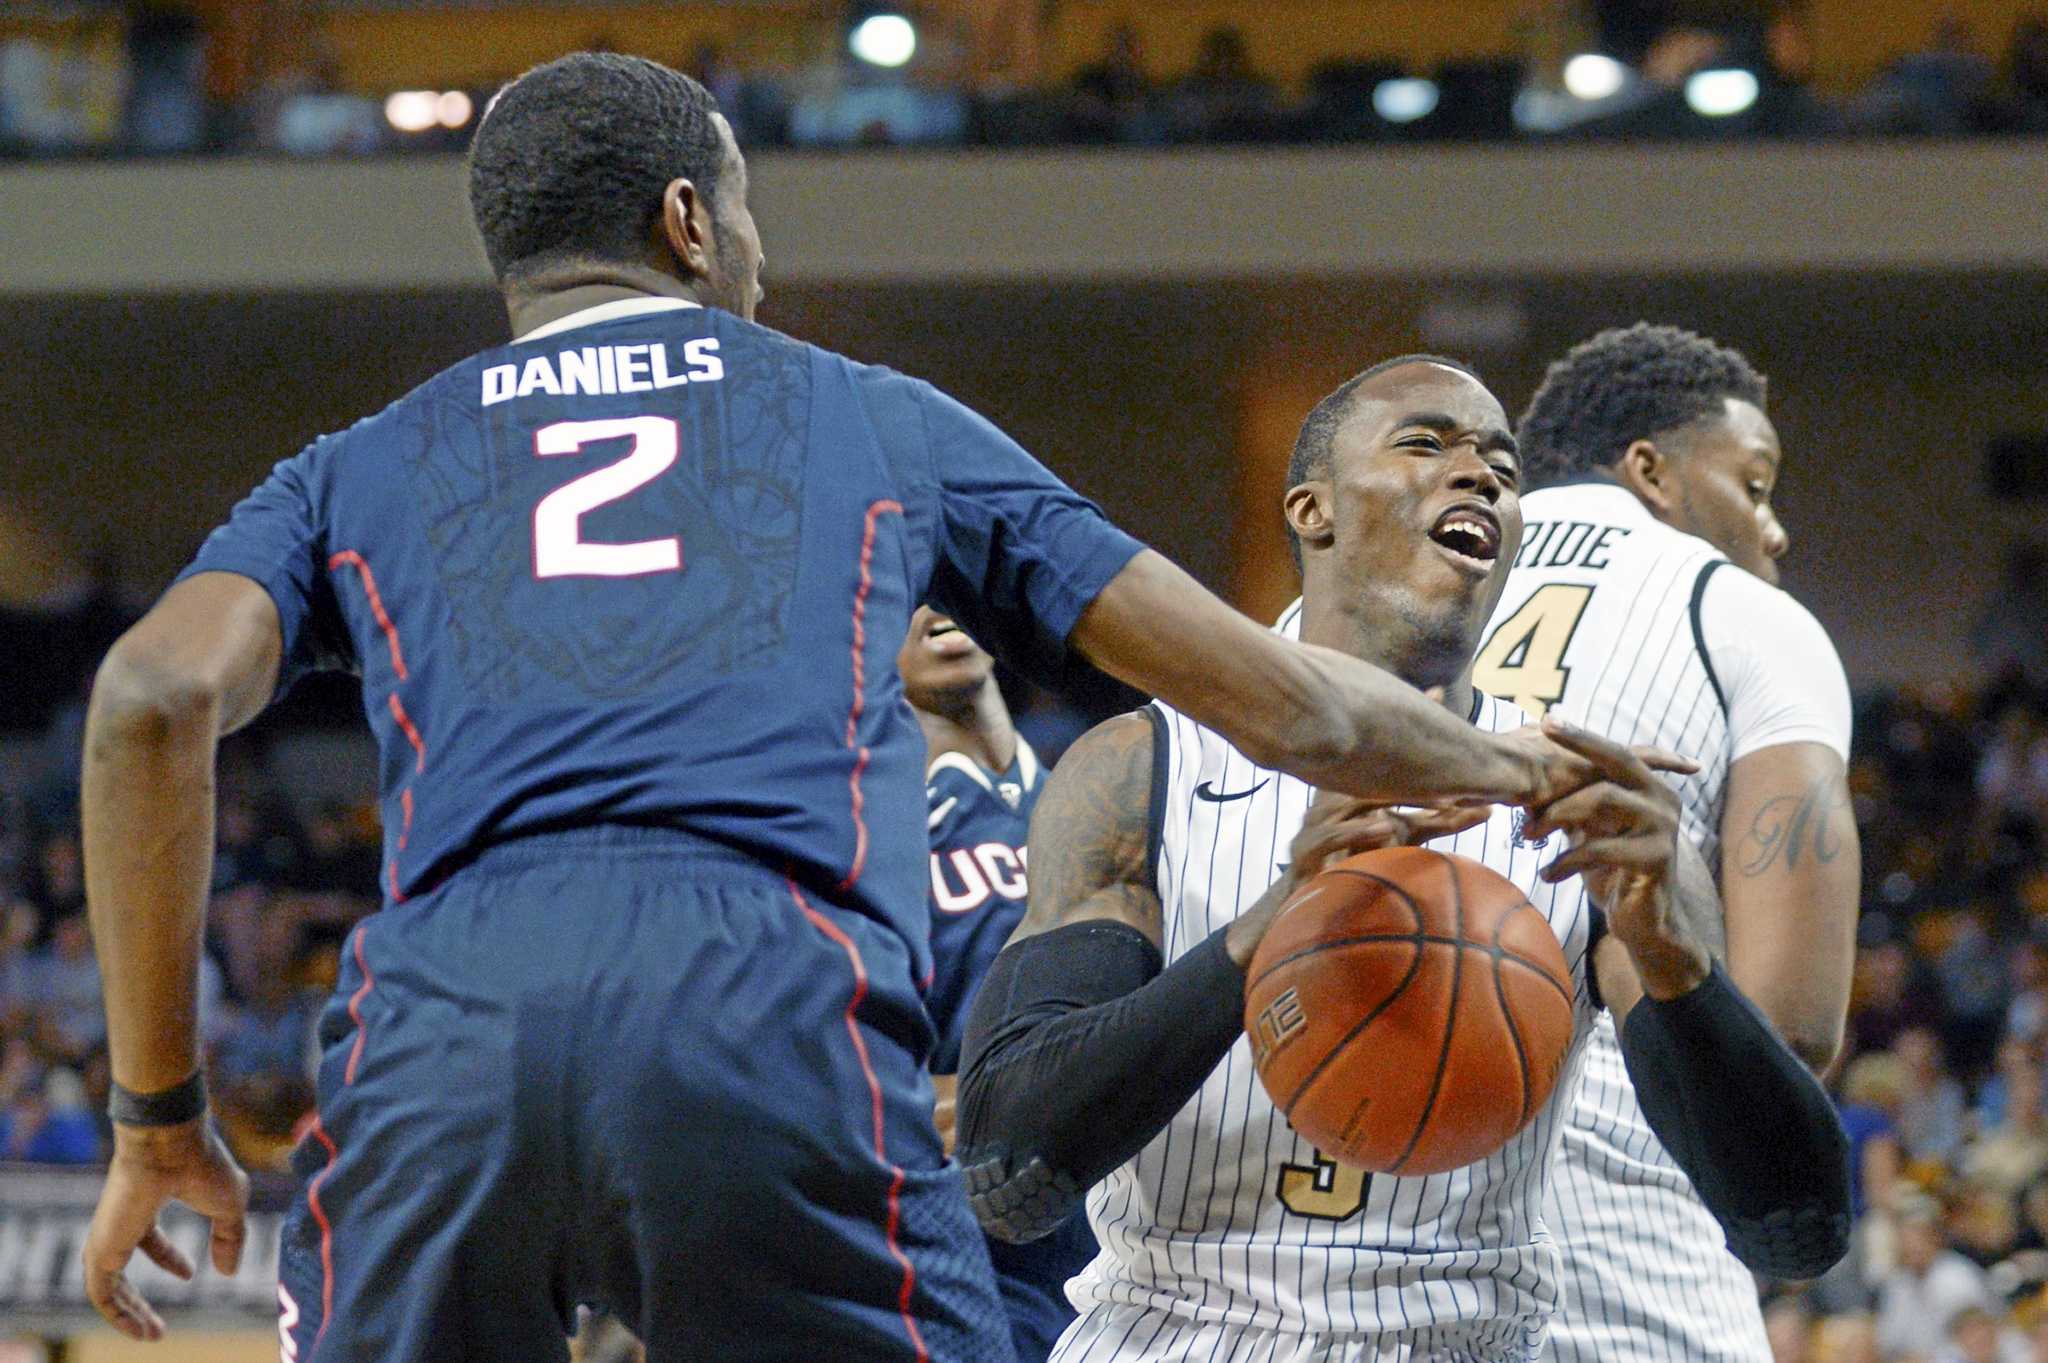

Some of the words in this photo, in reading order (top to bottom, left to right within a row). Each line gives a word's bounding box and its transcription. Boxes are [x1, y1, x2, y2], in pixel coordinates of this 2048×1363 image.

[481, 337, 724, 407] DANIELS
[532, 414, 684, 581] 2
[1472, 583, 1597, 722] 4
[929, 842, 1029, 914] UC
